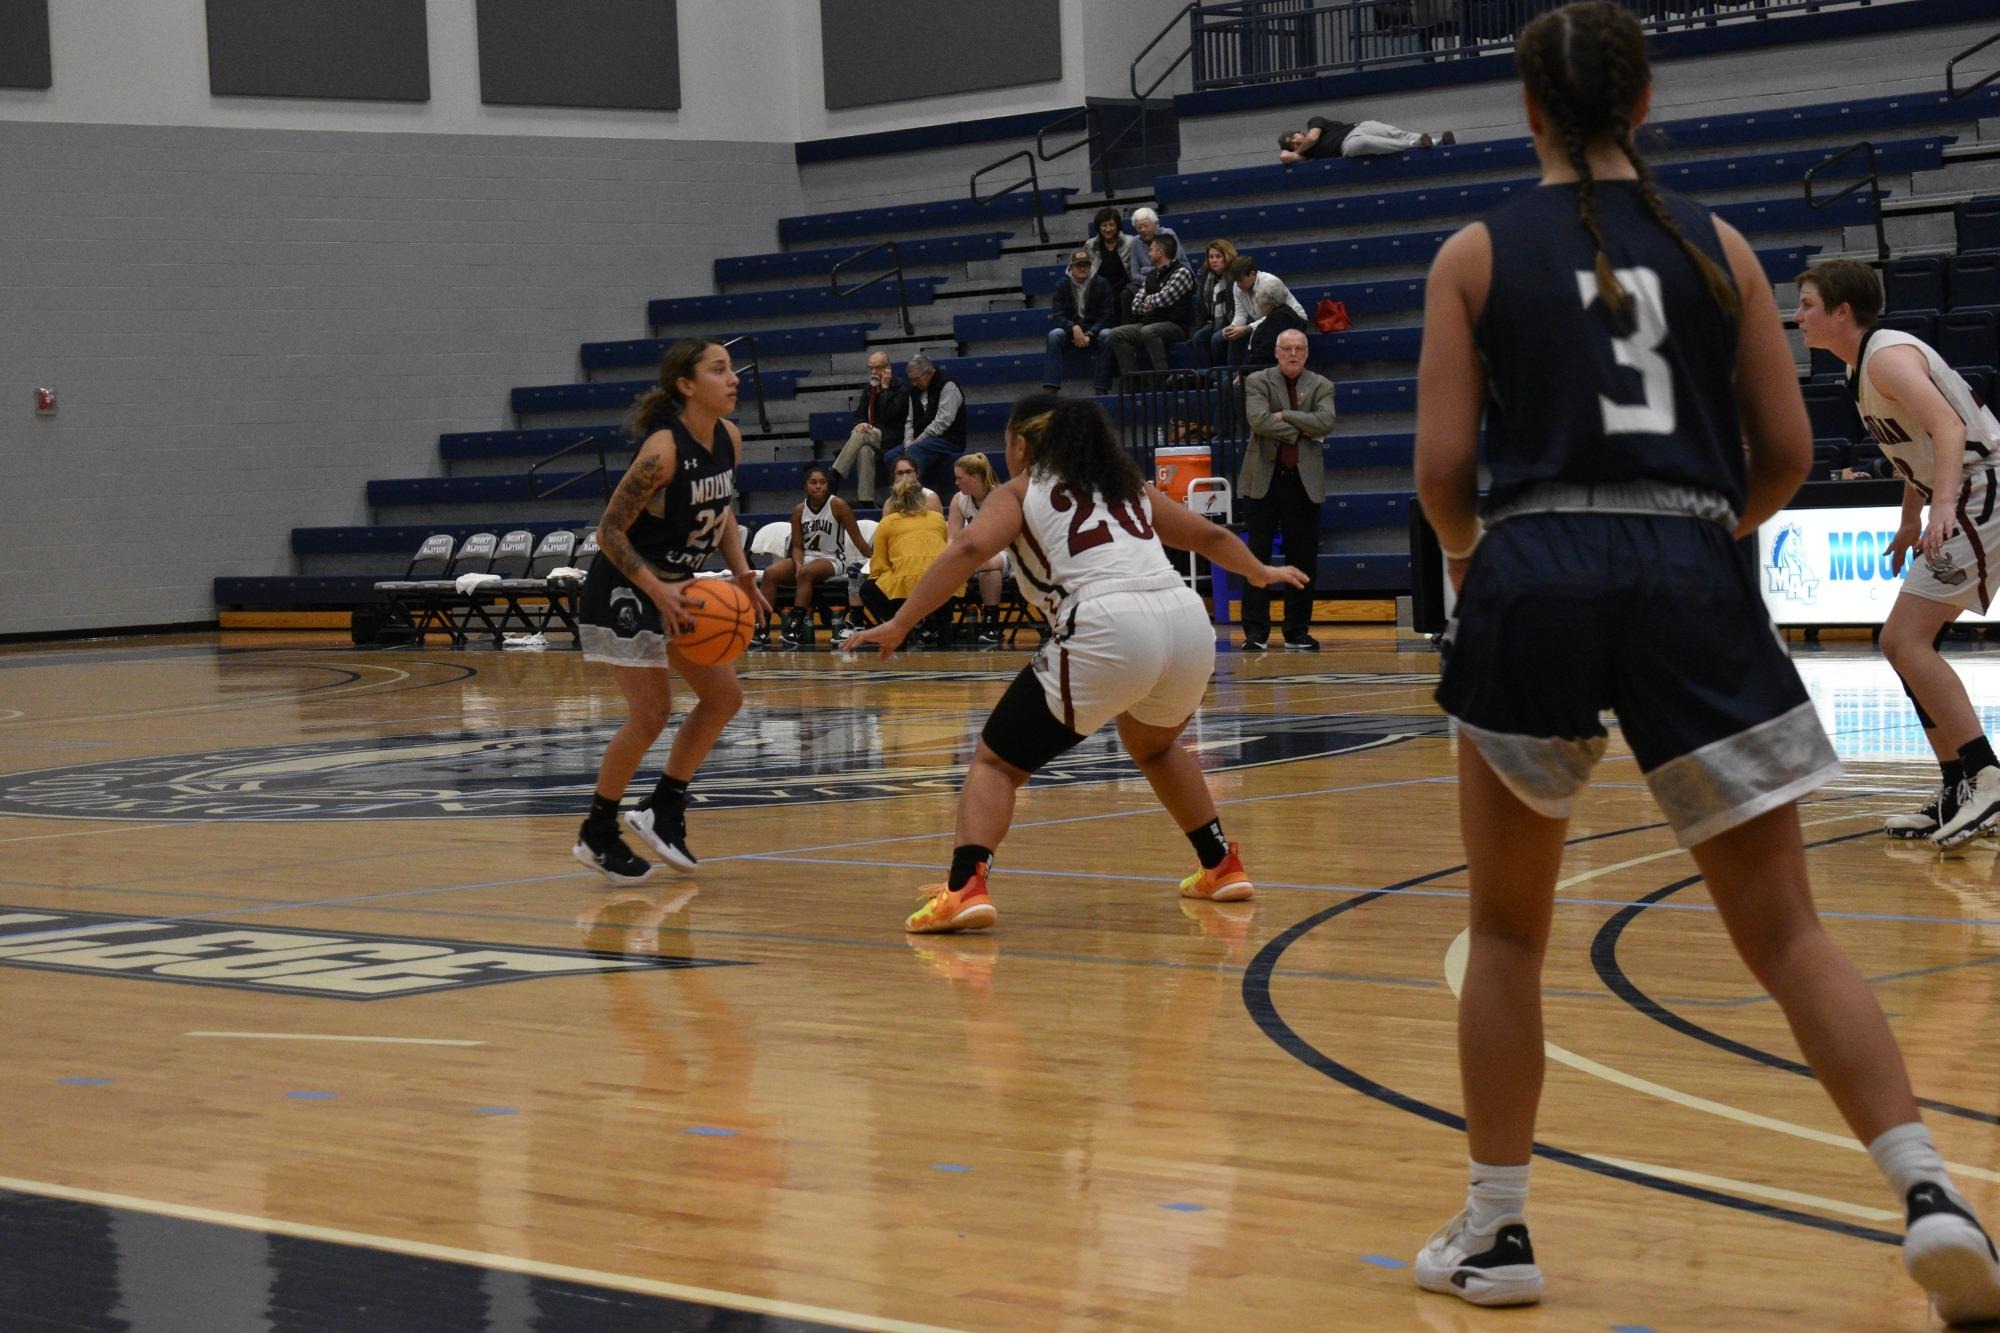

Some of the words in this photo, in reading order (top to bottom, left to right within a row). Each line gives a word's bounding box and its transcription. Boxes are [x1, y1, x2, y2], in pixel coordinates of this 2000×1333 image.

[1575, 266, 1676, 436] 3
[1050, 482, 1154, 557] 20
[1765, 566, 1818, 603] MAC
